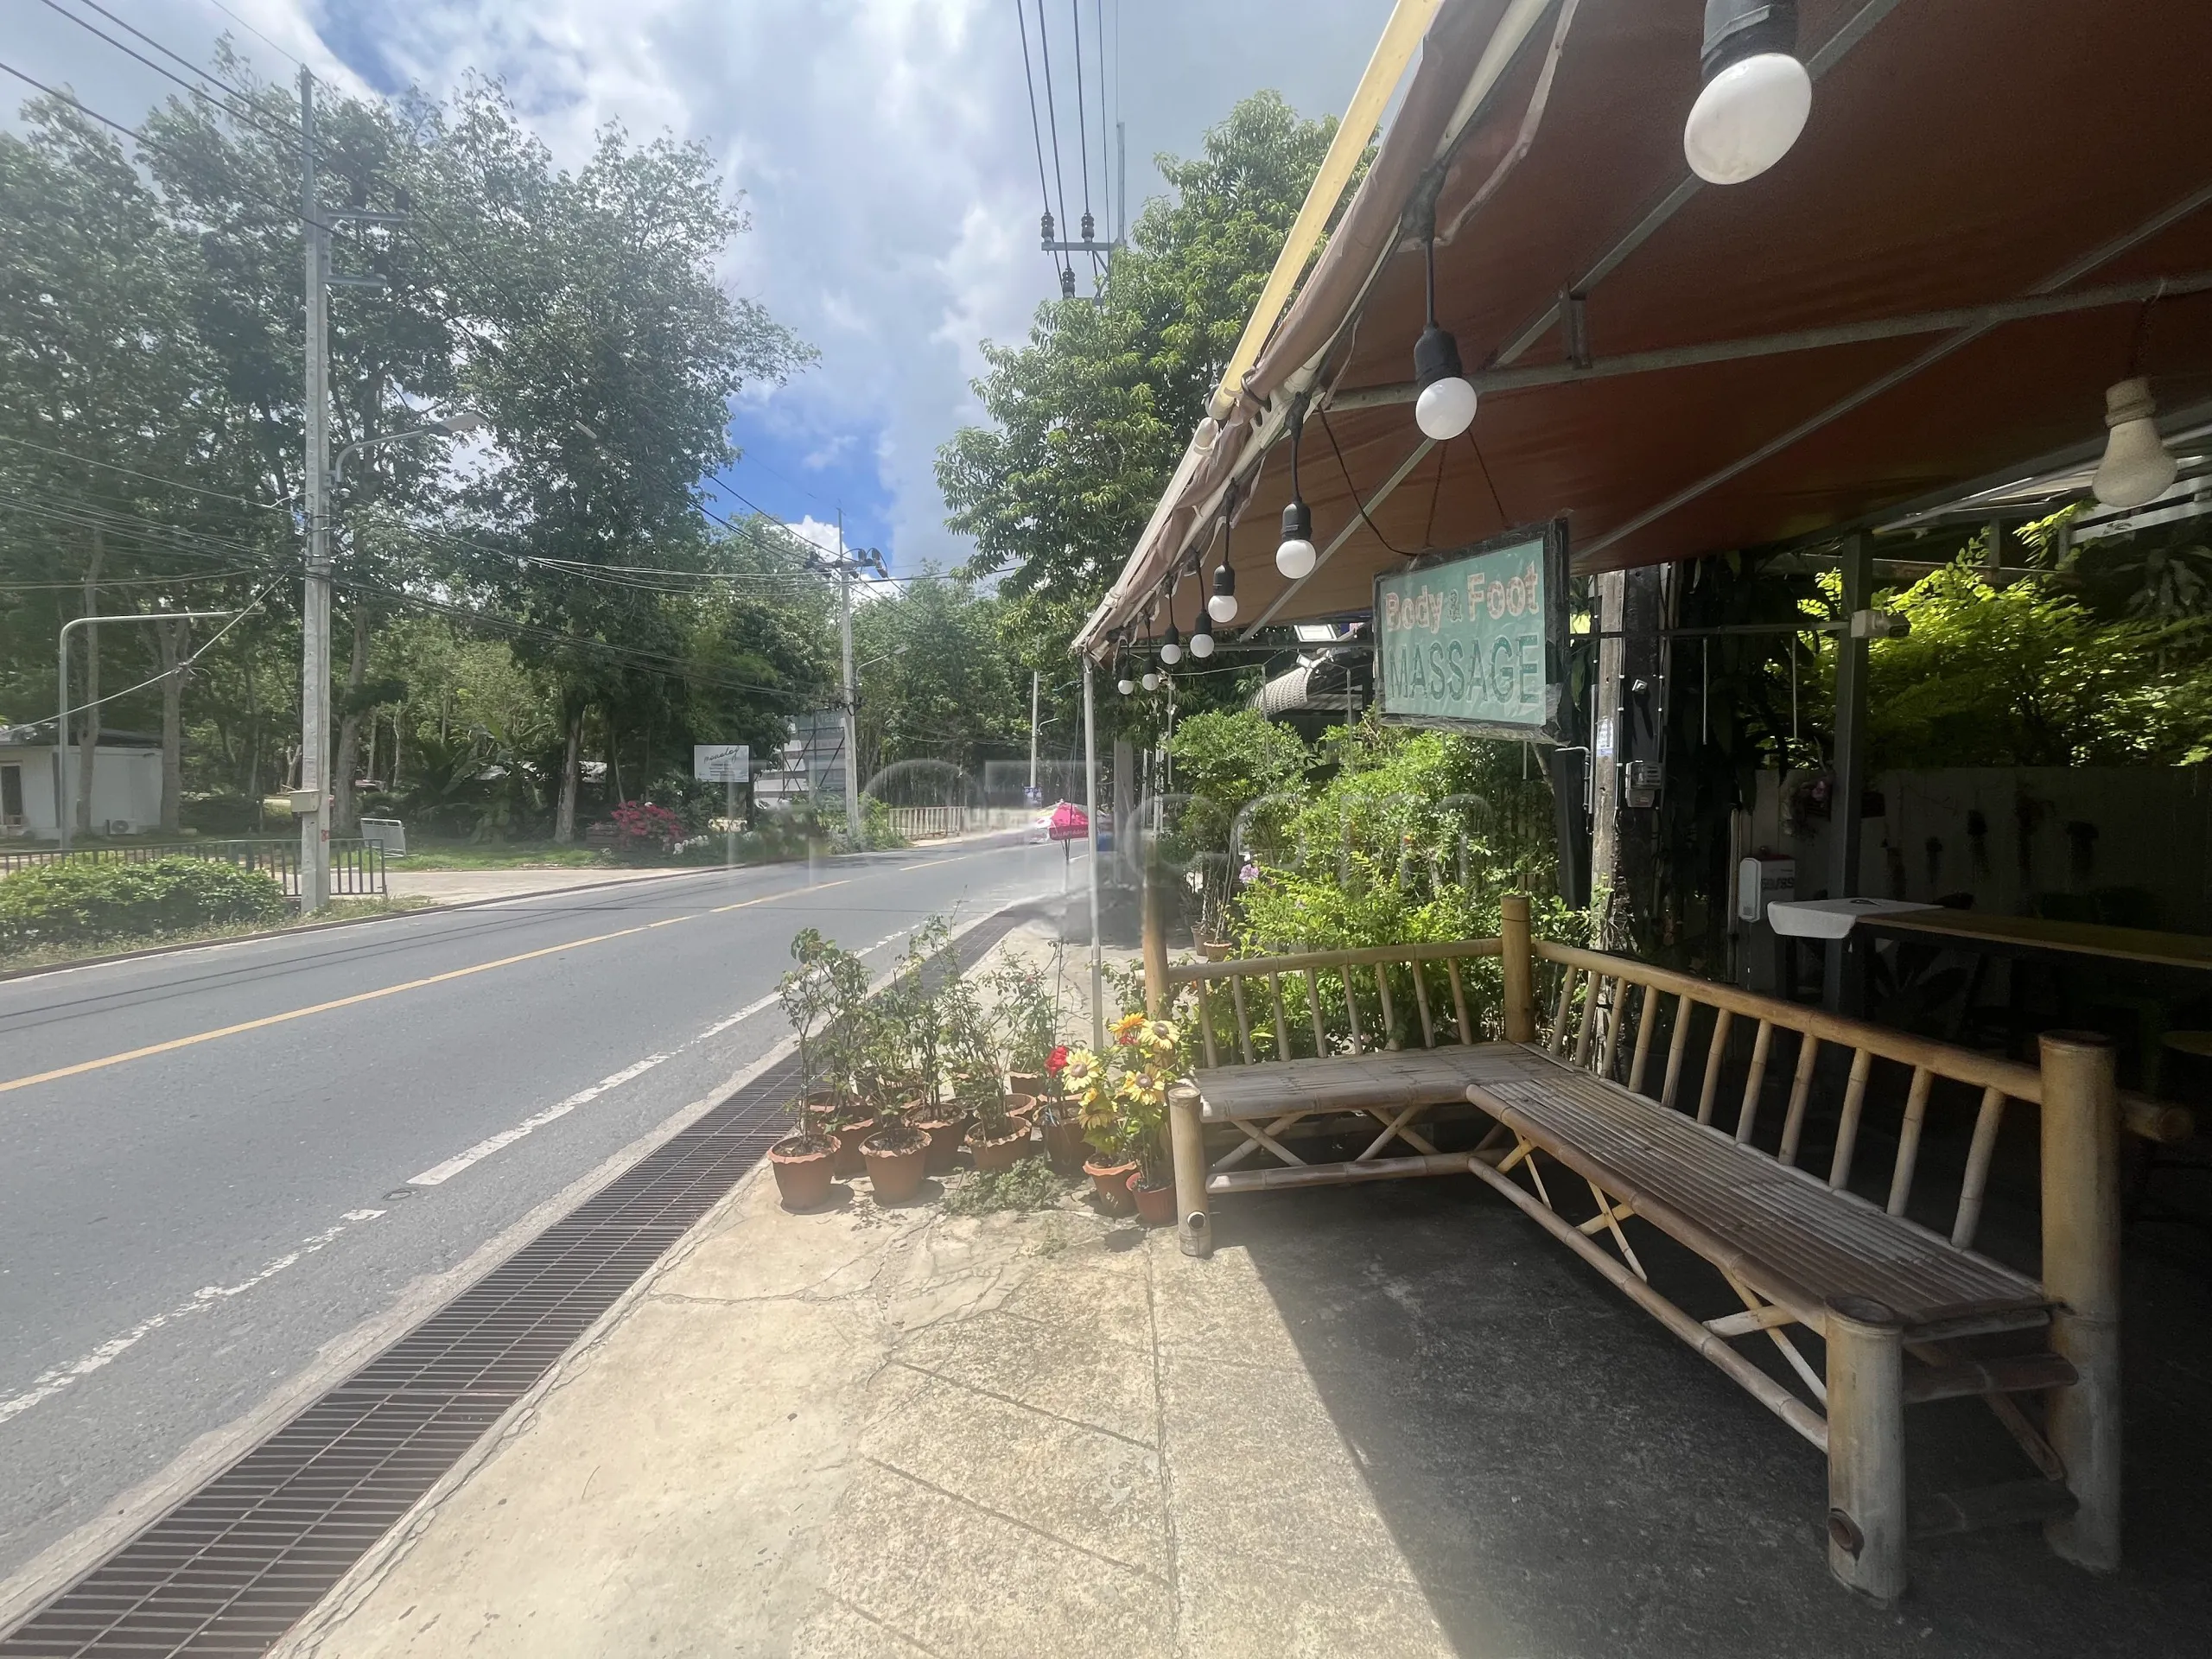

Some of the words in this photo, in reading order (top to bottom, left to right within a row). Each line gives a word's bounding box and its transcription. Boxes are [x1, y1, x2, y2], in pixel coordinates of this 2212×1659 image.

[1385, 585, 1444, 634] Body
[1447, 588, 1463, 622] &
[1467, 560, 1540, 621] Foot
[1389, 632, 1540, 704] MASSAGE
